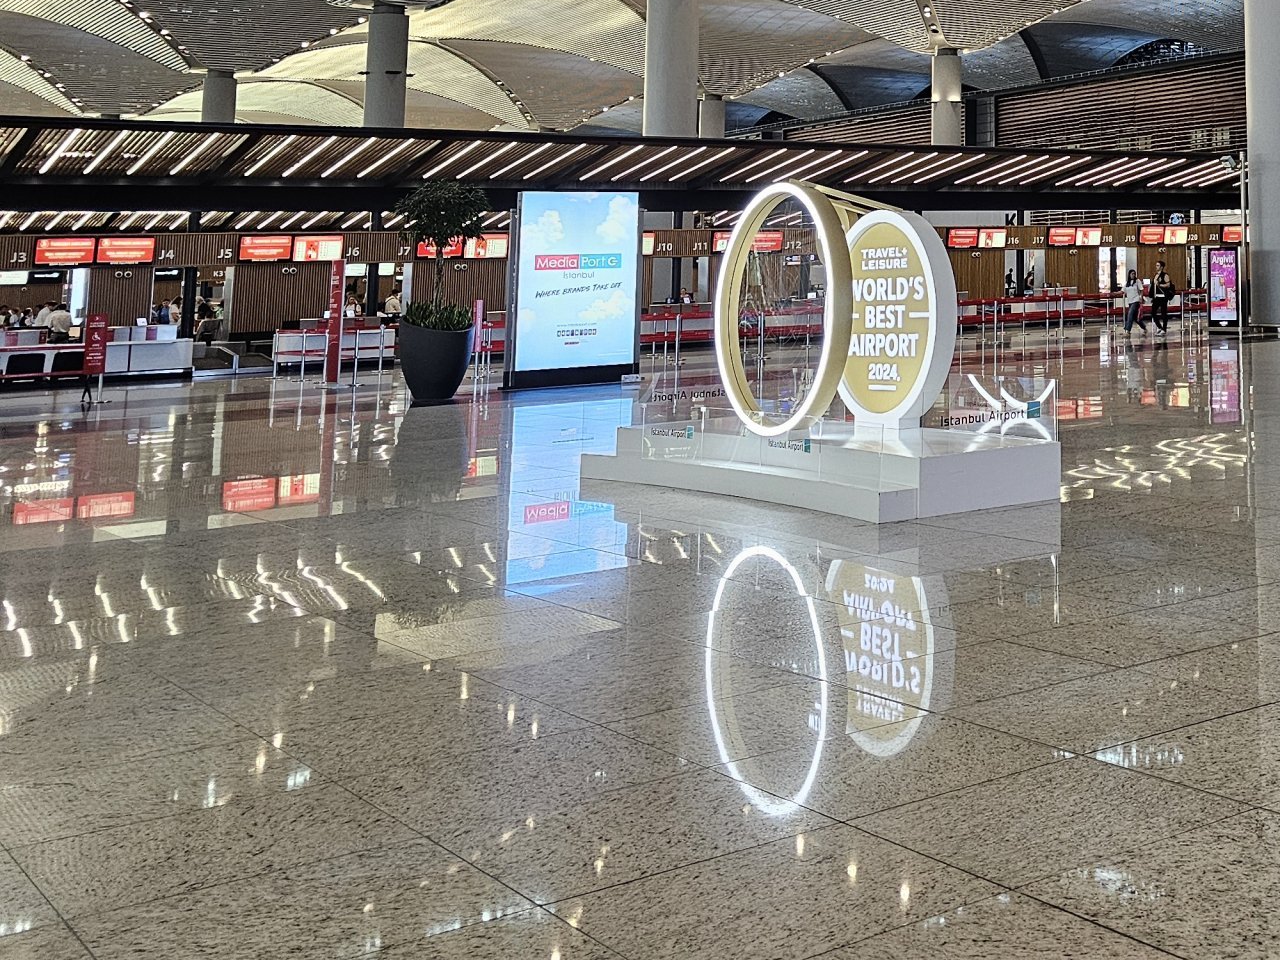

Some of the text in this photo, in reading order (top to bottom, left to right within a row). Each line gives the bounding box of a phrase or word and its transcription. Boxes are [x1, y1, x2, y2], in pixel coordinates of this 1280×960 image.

[1005, 212, 1017, 226] K
[1007, 237, 1020, 245] J16
[1032, 236, 1045, 244] J17
[1102, 235, 1113, 243] J18
[1209, 233, 1219, 241] J21
[398, 246, 411, 256] J7
[656, 243, 673, 252] J10
[693, 242, 708, 251] J11
[785, 241, 802, 250] J12
[10, 252, 27, 263] J3
[158, 249, 175, 260] J4
[217, 248, 233, 259] J5
[346, 247, 360, 257] J6
[861, 246, 908, 259] TRAVEL+
[537, 256, 605, 268] Media Port
[861, 258, 908, 271] LEISURE
[535, 289, 560, 299] WHERE
[562, 286, 591, 295] BRANDS
[593, 283, 608, 291] TAKE
[864, 305, 906, 329] BEST
[848, 333, 919, 358] AIRPORT
[940, 409, 1025, 427] Istanbul Airport
[670, 428, 686, 439] Airport
[787, 440, 804, 452] Airport
